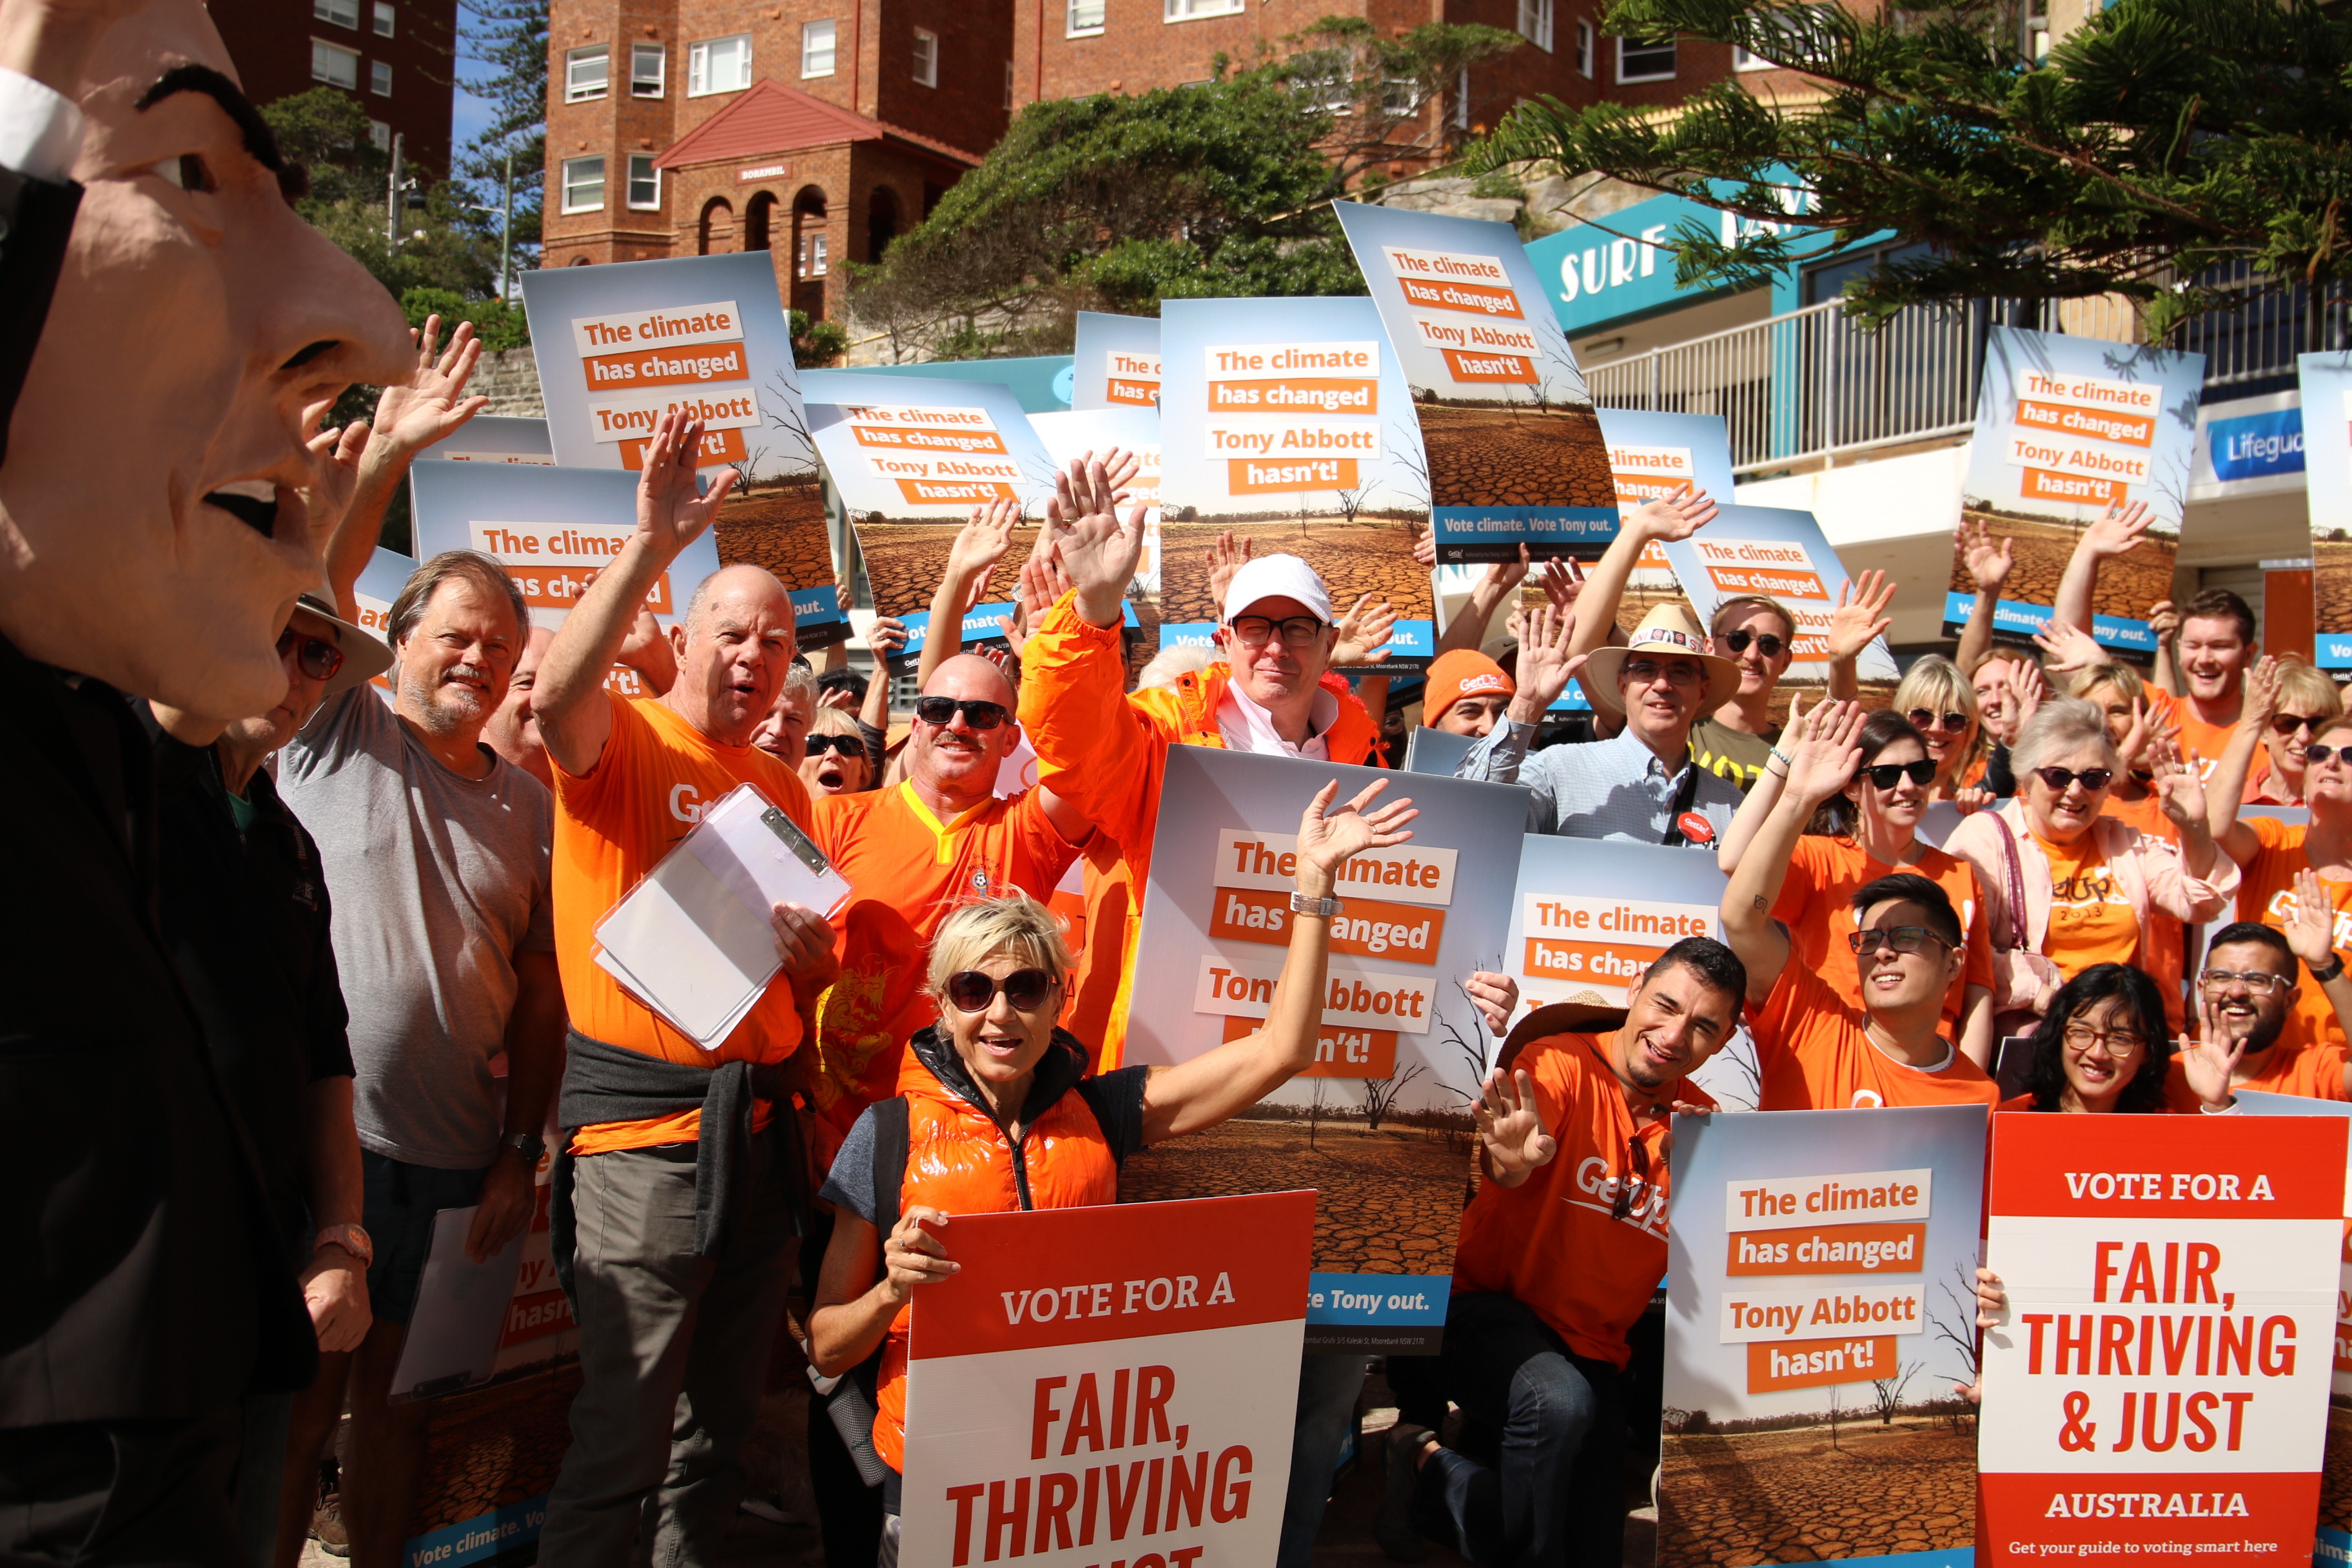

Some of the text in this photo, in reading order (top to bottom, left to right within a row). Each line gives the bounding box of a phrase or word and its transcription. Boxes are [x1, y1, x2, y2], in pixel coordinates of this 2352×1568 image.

[742, 166, 785, 180] BORAMBIL
[1392, 253, 1500, 279] The climate
[1560, 223, 1666, 303] SURF
[1406, 281, 1515, 313] has changed
[583, 312, 731, 346] The climate
[1419, 321, 1535, 349] Tony Abbott
[593, 351, 739, 381] has changed
[1115, 357, 1149, 374] The
[1216, 349, 1369, 371] The climate
[1456, 355, 1523, 375] hasn't!
[1113, 382, 1145, 400] has
[1217, 384, 1369, 411] has changed
[2029, 376, 2152, 407] The climate
[597, 409, 658, 433] Tony
[848, 407, 984, 424] The climate
[2023, 403, 2148, 440] has changed
[860, 428, 998, 451] has changed
[1212, 428, 1374, 455] Tony Abbott
[2227, 431, 2305, 463] Lifegua
[871, 458, 1019, 477] Tony Abbott
[2015, 440, 2144, 476] Tony Abbott
[1248, 460, 1338, 485] hasn't!
[2036, 473, 2112, 499] hasn't!
[914, 483, 999, 498] hasn't!
[1445, 518, 1474, 533] Vote
[1477, 517, 1526, 533] climate.
[1529, 518, 1556, 533] Vote
[1558, 518, 1587, 535] Tony
[1589, 519, 1612, 532] out.
[483, 529, 632, 556] The clima
[1698, 543, 1805, 562] The climate
[514, 576, 540, 597] as
[1713, 569, 1821, 596] has changed
[794, 600, 825, 616] out.
[2093, 623, 2118, 640] ony
[2121, 628, 2148, 642] out.
[1459, 674, 1505, 692] GetUp!
[1684, 818, 1710, 836] GetUp!
[967, 863, 992, 872] BHUTAN
[1233, 841, 1440, 888] The imate
[2052, 876, 2111, 903] etUp
[1224, 894, 1431, 952] has anged
[1536, 902, 1707, 936] The climate
[2061, 906, 2102, 921] 2013
[1534, 942, 1583, 971] has
[1209, 967, 1425, 1018] Ton bbott
[1740, 1182, 1919, 1218] The climate
[2064, 1172, 2275, 1201] VOTE FOR A
[1738, 1234, 1915, 1269] has changed
[2093, 1241, 2235, 1311] FAIR,
[1001, 1271, 1237, 1325] VOTE FOR A
[1331, 1289, 1384, 1315] Tony
[1387, 1292, 1430, 1310] out.
[1730, 1295, 1916, 1335] Tony Abbott
[1371, 1337, 1400, 1346] Moorebank
[1412, 1337, 1425, 1346] 2170
[2021, 1313, 2298, 1378] THRIVING
[1770, 1339, 1875, 1378] hasn't!
[1031, 1364, 1190, 1460] FAIR,
[2058, 1390, 2255, 1453] & JUST
[945, 1444, 1253, 1567] THRIVING
[2044, 1493, 2249, 1518] AUSTRALIA
[412, 1544, 452, 1568] Vote
[456, 1521, 521, 1554] climate.
[2009, 1540, 2278, 1556] Get your guide to voting smart here
